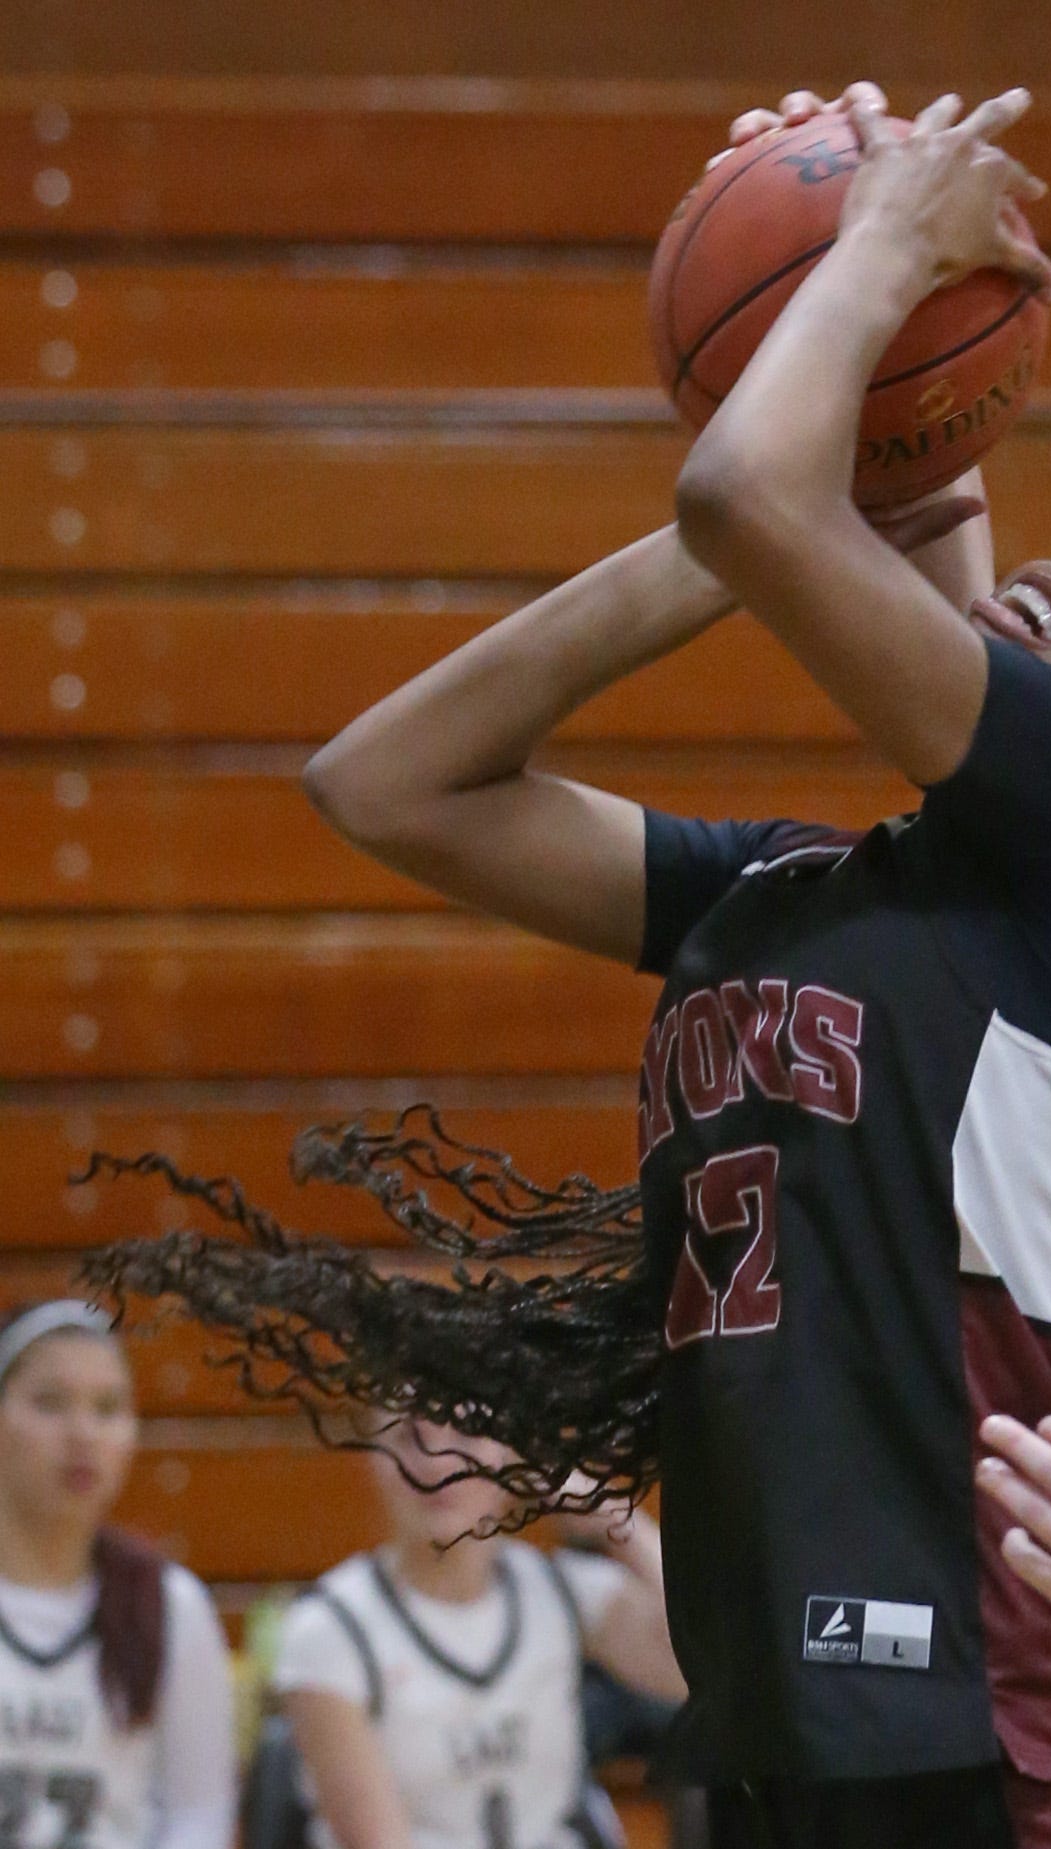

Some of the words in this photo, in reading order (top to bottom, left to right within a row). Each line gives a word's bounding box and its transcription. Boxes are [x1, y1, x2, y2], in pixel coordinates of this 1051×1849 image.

[857, 344, 1034, 470] PALDIN
[638, 978, 864, 1168] YONS
[892, 1640, 904, 1658] L
